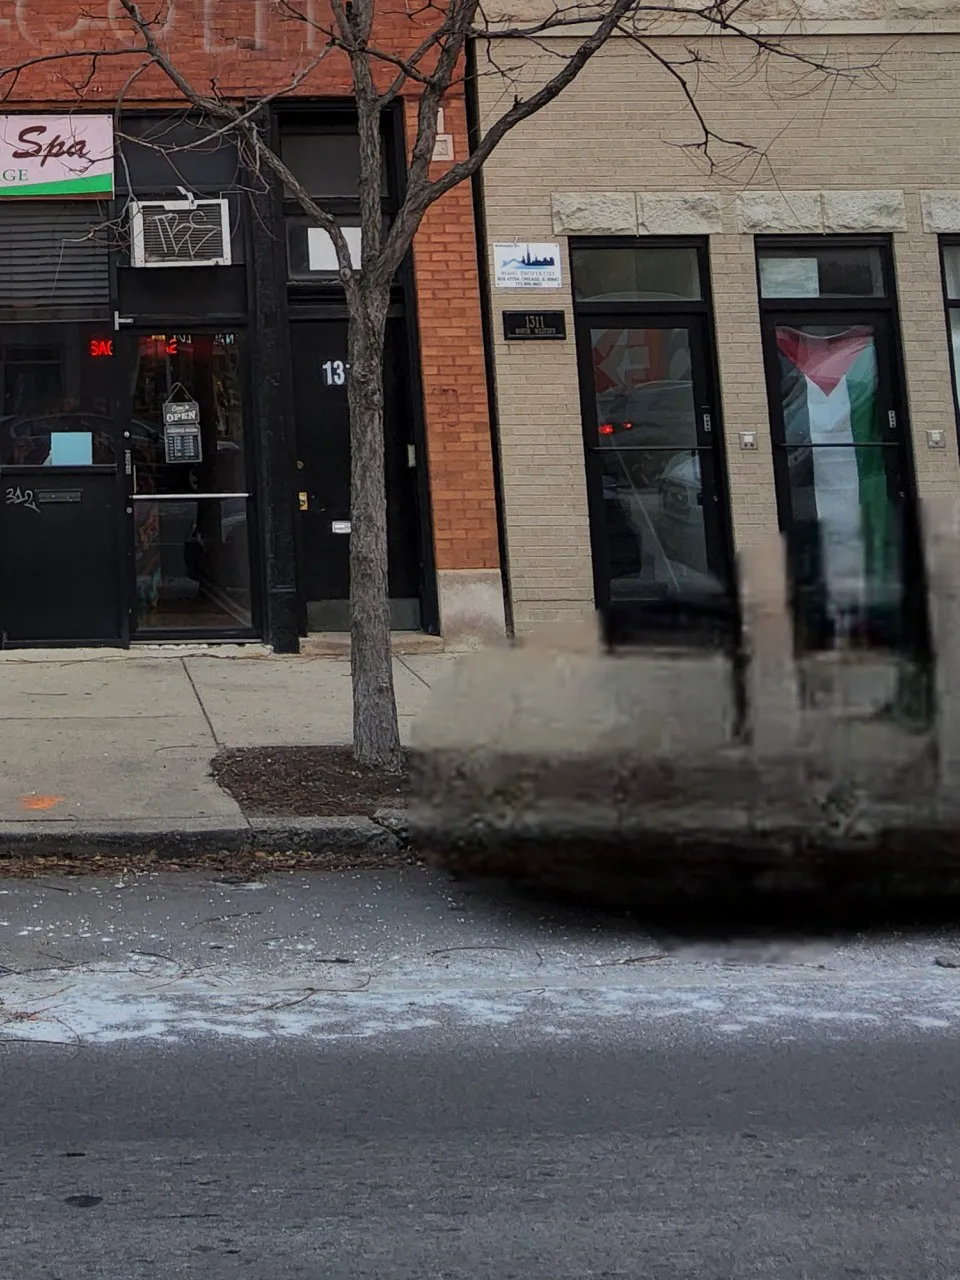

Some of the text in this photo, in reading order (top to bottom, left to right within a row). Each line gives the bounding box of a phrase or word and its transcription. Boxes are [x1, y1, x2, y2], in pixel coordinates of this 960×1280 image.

[12, 126, 91, 167] Spa
[525, 316, 545, 328] 1311
[322, 360, 350, 386] 13
[166, 410, 196, 422] OPEN
